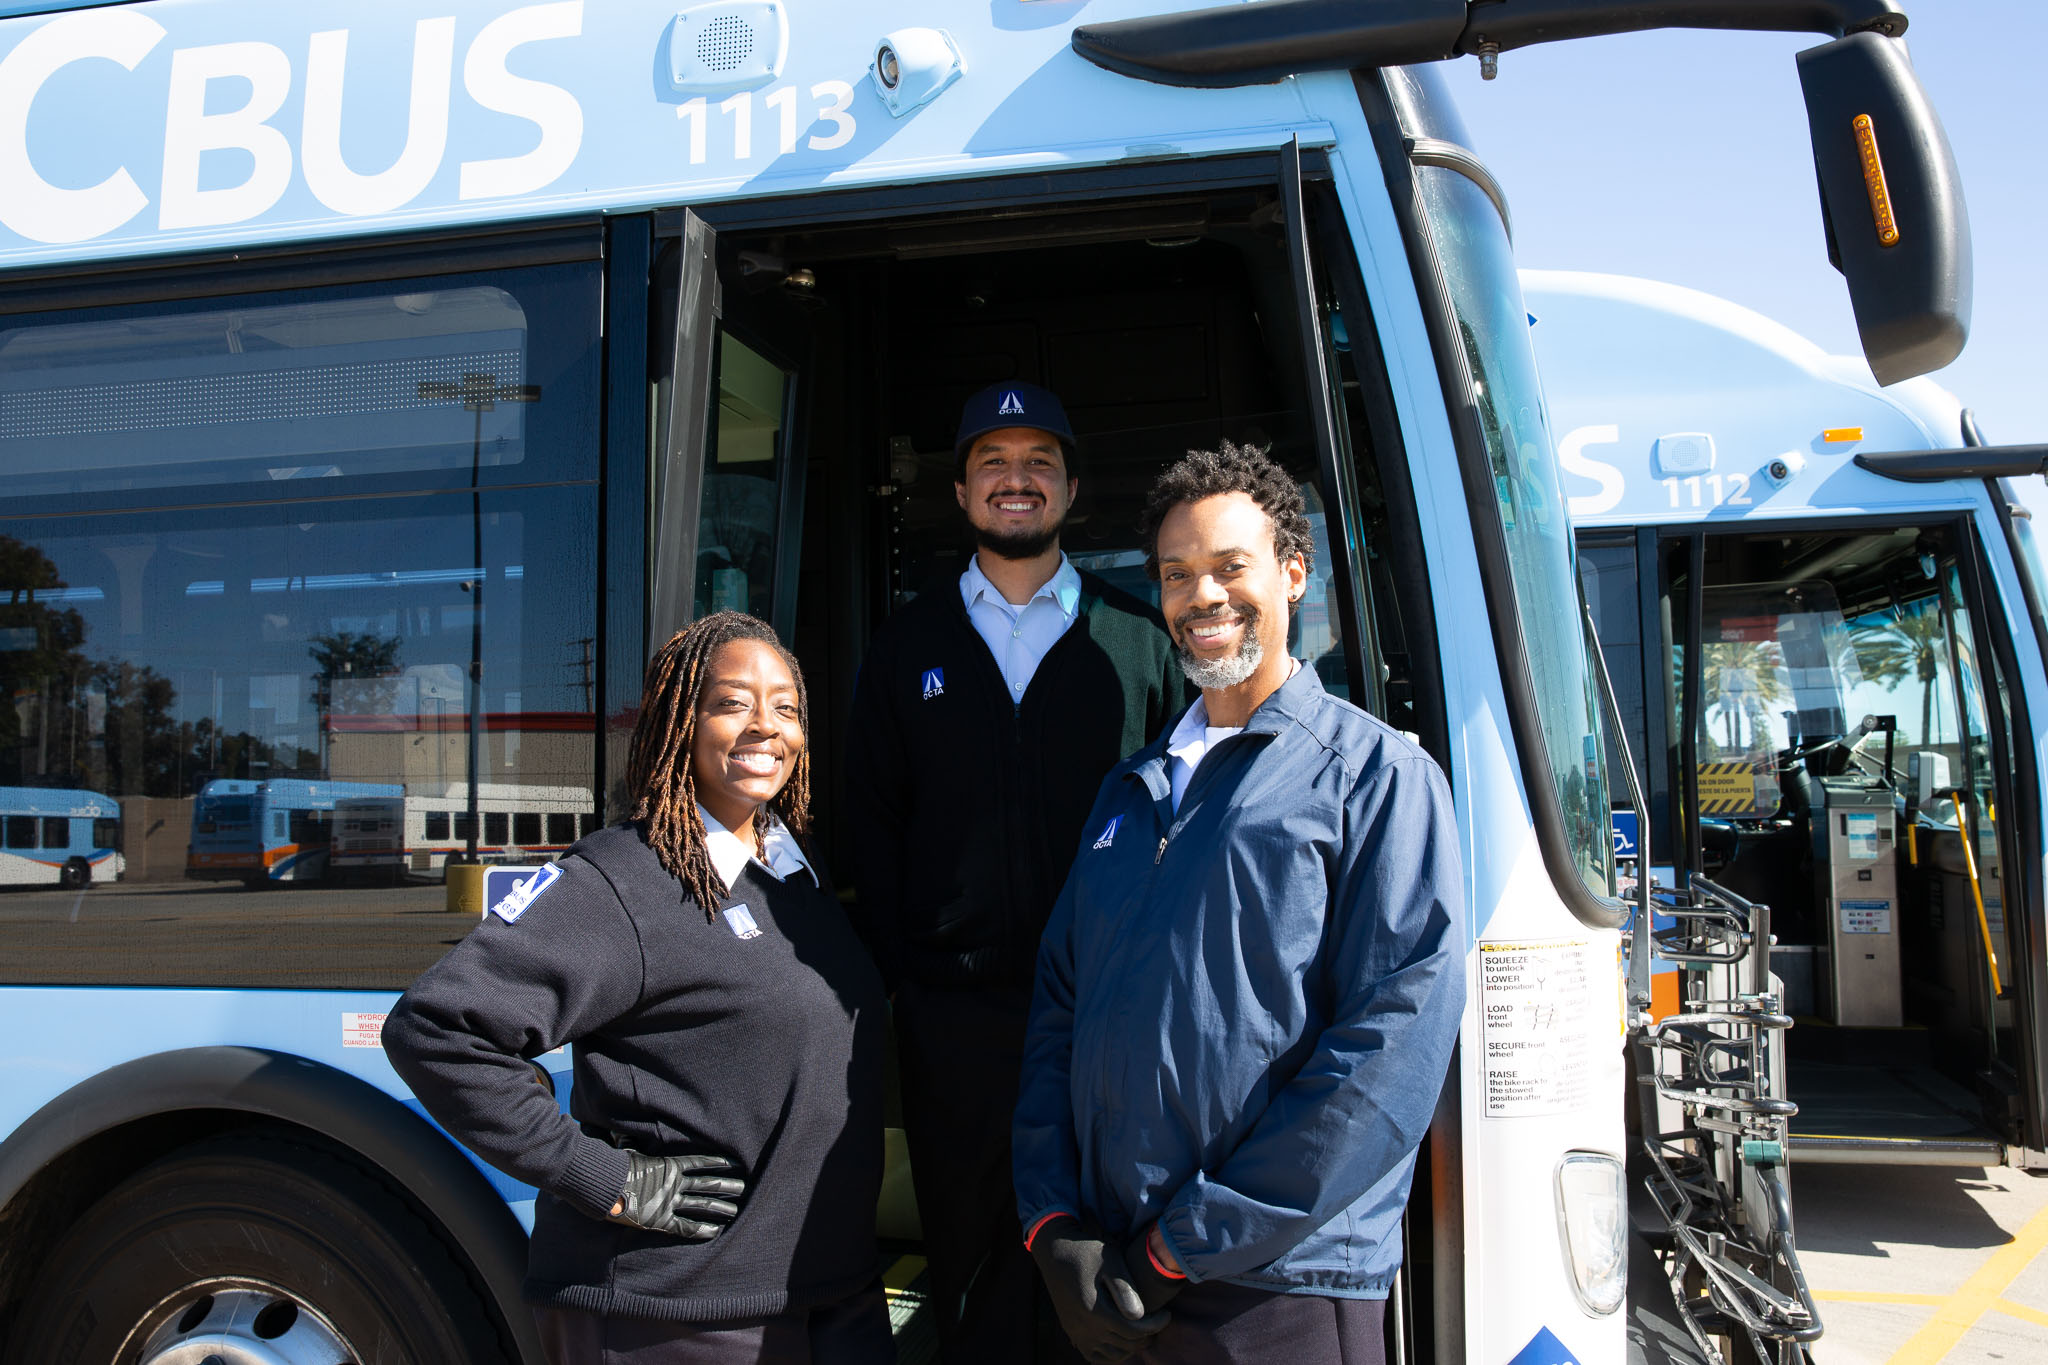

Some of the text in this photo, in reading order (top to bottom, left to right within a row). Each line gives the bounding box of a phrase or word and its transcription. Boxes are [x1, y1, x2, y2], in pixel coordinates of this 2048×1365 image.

[0, 0, 584, 243] CBUS
[676, 80, 857, 165] 1113
[1662, 473, 1752, 508] 1112
[923, 687, 944, 700] OCTA
[1093, 839, 1112, 850] OCTA
[1485, 956, 1529, 965] SQUEEZE
[1496, 964, 1525, 972] unlock
[1486, 975, 1520, 983] LOWER
[1503, 983, 1535, 992] position
[1487, 1005, 1514, 1013] LOAD
[357, 1013, 388, 1021] HYDRO
[1488, 1013, 1508, 1021] front
[1489, 1042, 1527, 1050] SECURE
[1504, 1086, 1534, 1094] stowed
